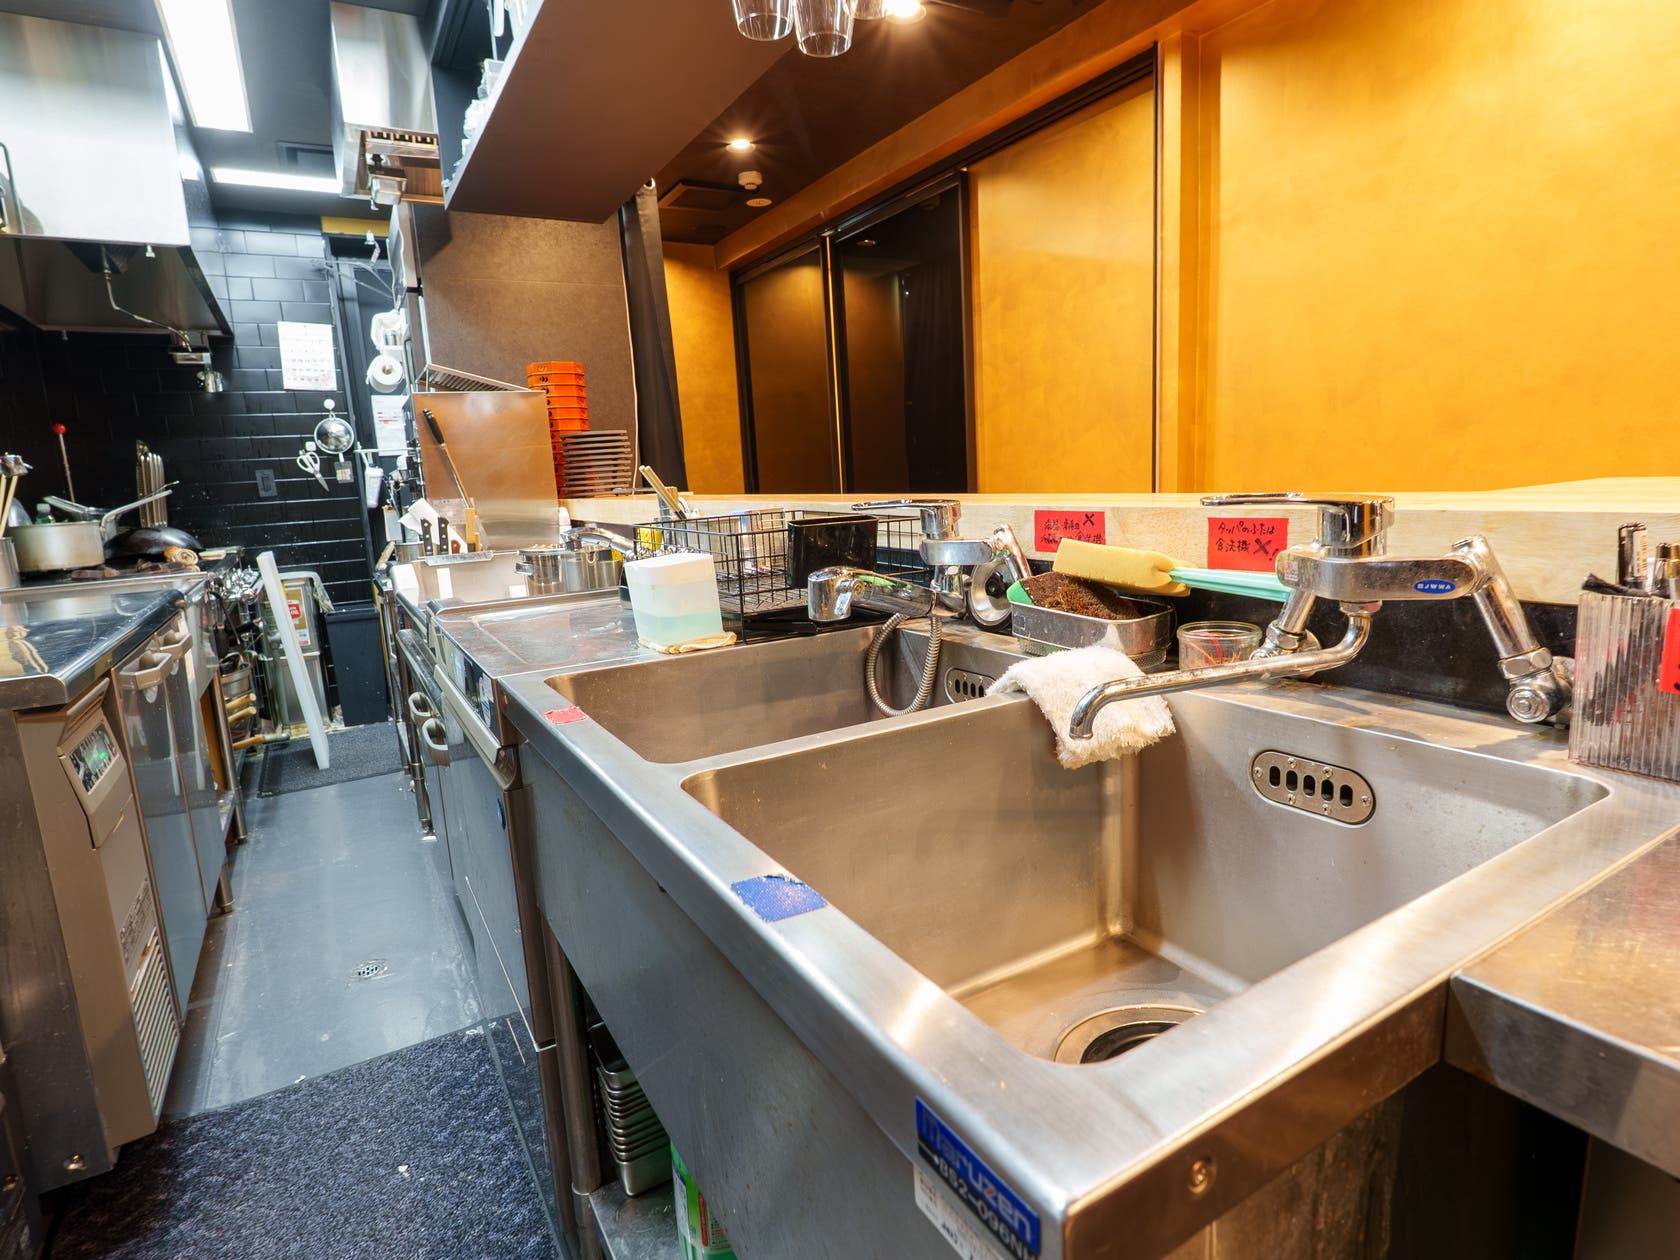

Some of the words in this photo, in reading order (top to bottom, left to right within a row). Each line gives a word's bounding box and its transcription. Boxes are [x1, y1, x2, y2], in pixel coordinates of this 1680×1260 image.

[1217, 520, 1276, 536] タッパのふたは
